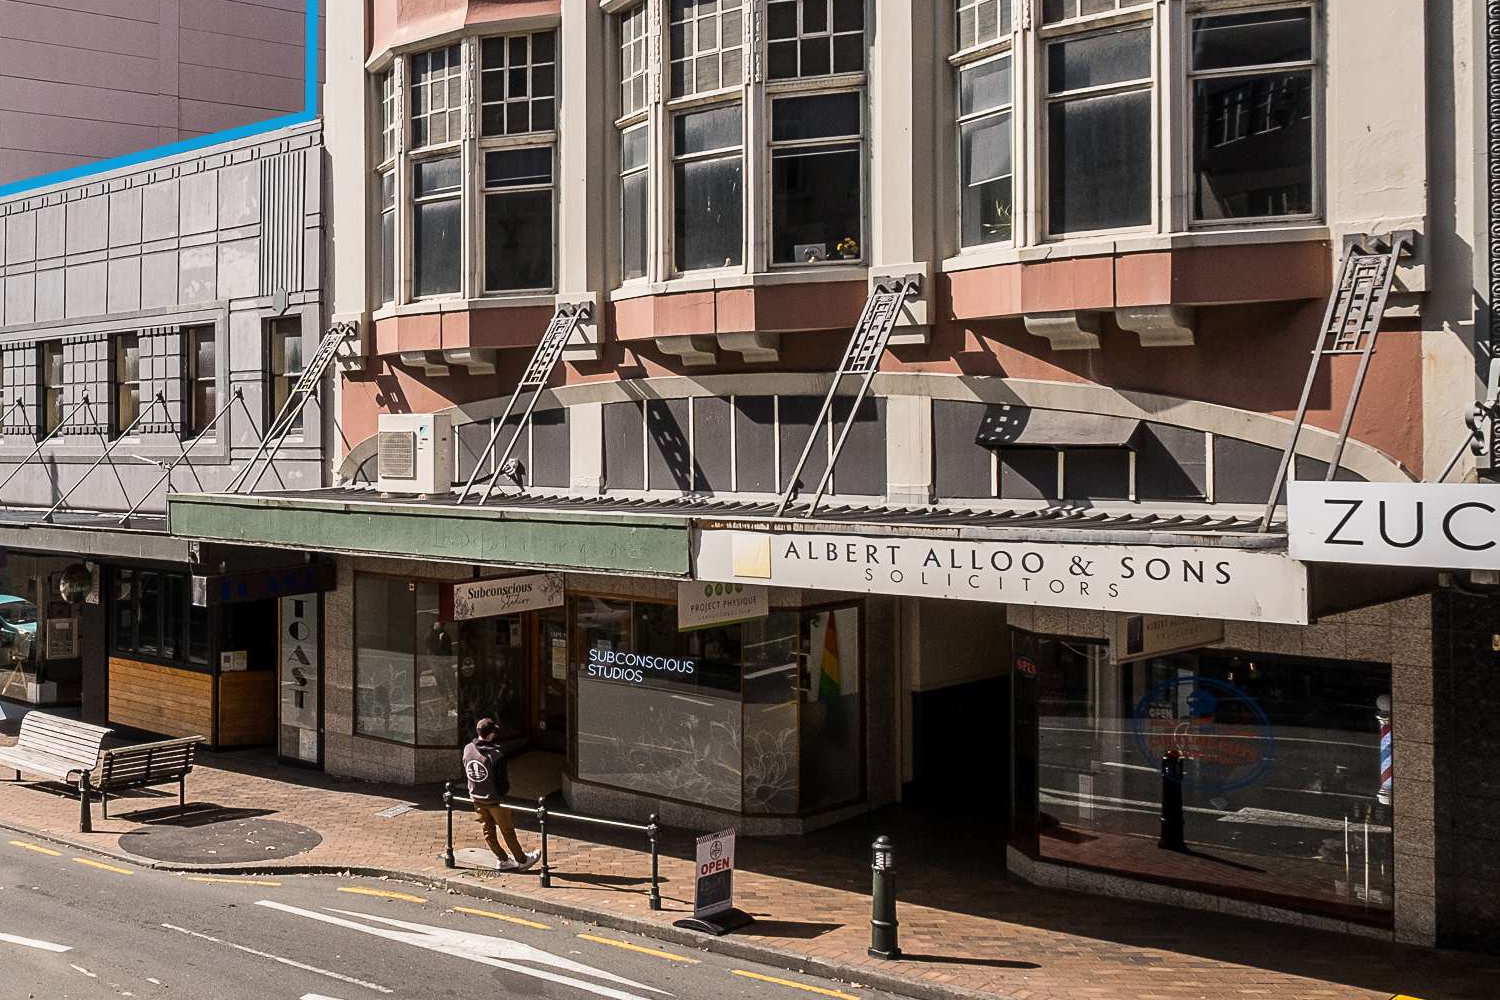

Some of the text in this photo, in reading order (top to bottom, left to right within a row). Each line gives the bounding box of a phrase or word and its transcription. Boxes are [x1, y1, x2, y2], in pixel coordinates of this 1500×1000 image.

[1324, 499, 1496, 551] ZUC
[784, 541, 1231, 585] ALBERT ALLOO & SONS
[468, 583, 533, 599] Subconscious
[865, 568, 1119, 598] SOLICITORS
[691, 595, 757, 613] PROJECT PHYSIQUE
[287, 599, 310, 709] TOAST
[589, 649, 694, 674] SUBCONSCIOUS
[588, 664, 643, 683] STUDIOS
[1149, 708, 1173, 719] OPEN
[701, 857, 730, 875] OPEN
